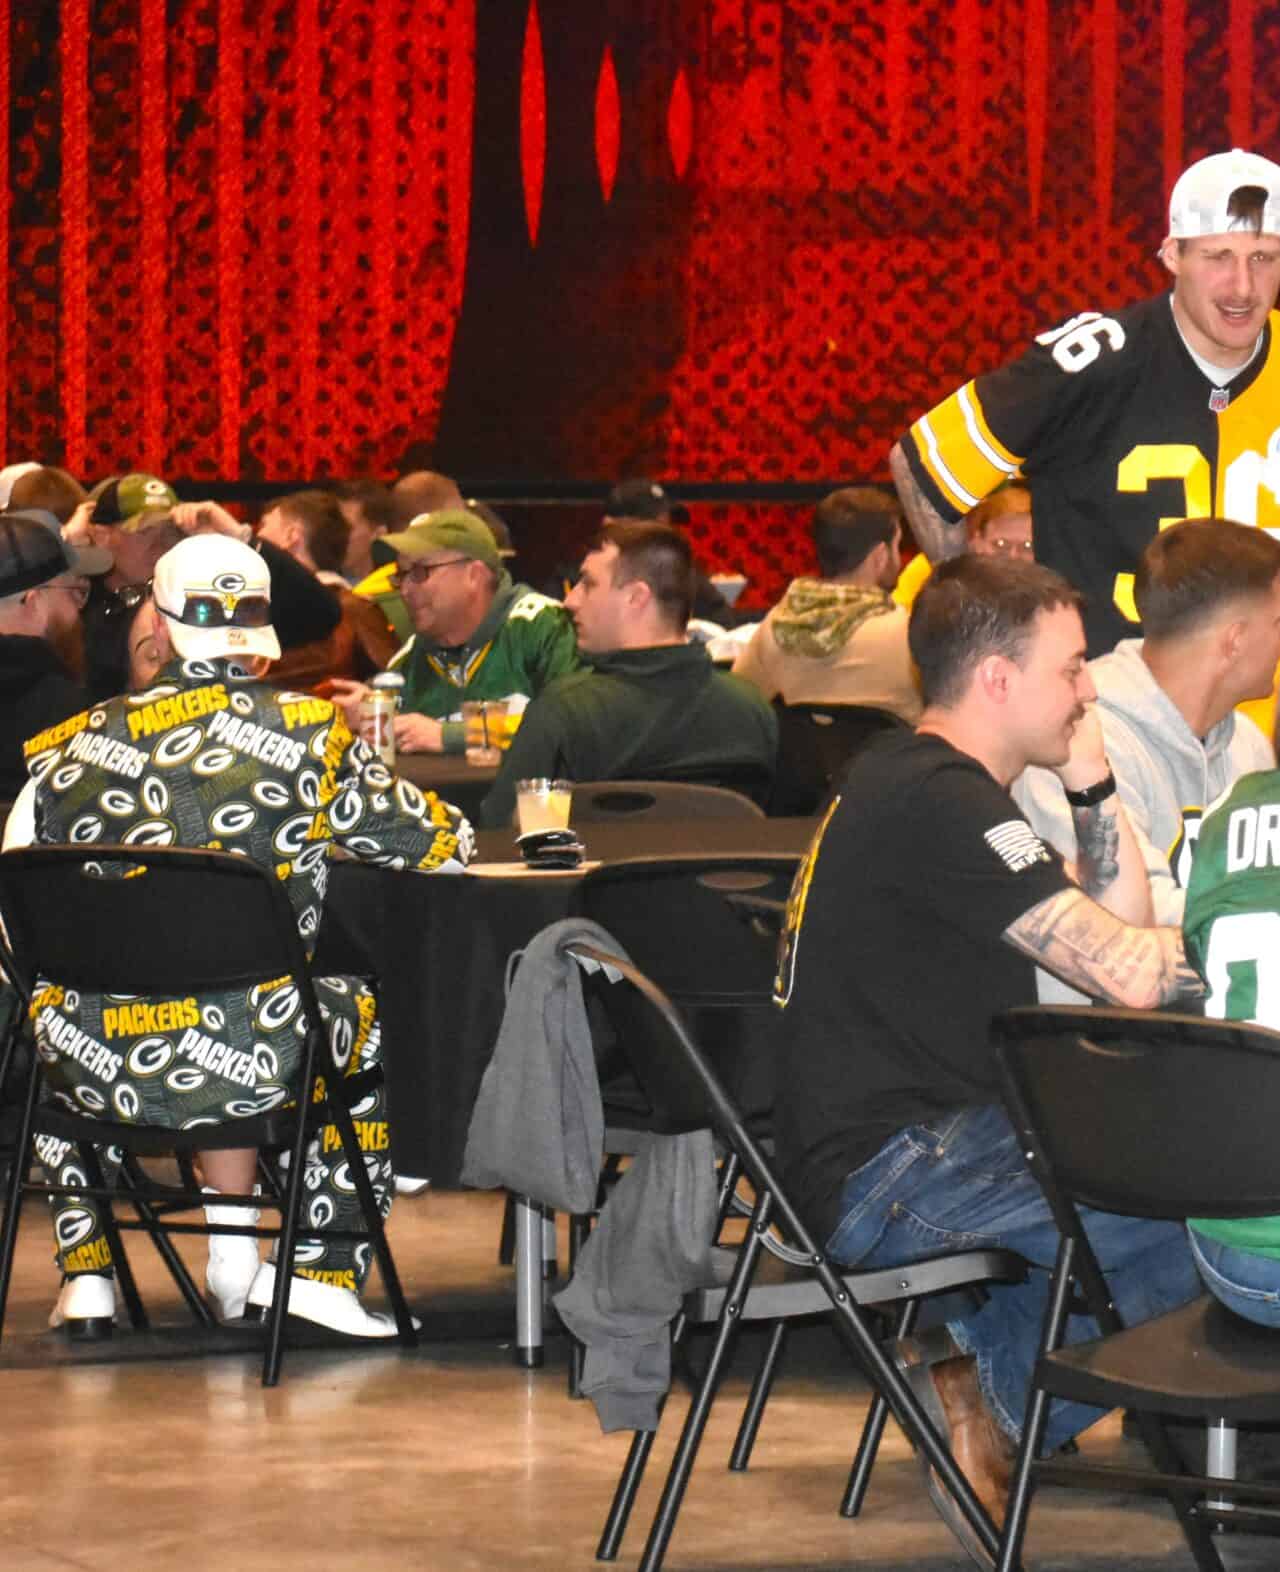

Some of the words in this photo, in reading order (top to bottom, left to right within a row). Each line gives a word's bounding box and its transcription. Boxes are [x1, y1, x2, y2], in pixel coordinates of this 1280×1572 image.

[127, 683, 230, 742] PACKERS
[64, 732, 149, 779] PACKERS
[154, 724, 204, 767] G
[191, 747, 236, 775] G
[206, 709, 306, 772] PACKERS
[101, 789, 136, 815] G
[253, 780, 291, 808] G
[211, 803, 257, 836] G
[104, 997, 201, 1040] PACKERS
[258, 984, 300, 1030] G
[40, 1006, 123, 1083] PACKERS
[127, 1036, 173, 1076] G
[166, 1068, 206, 1091] G
